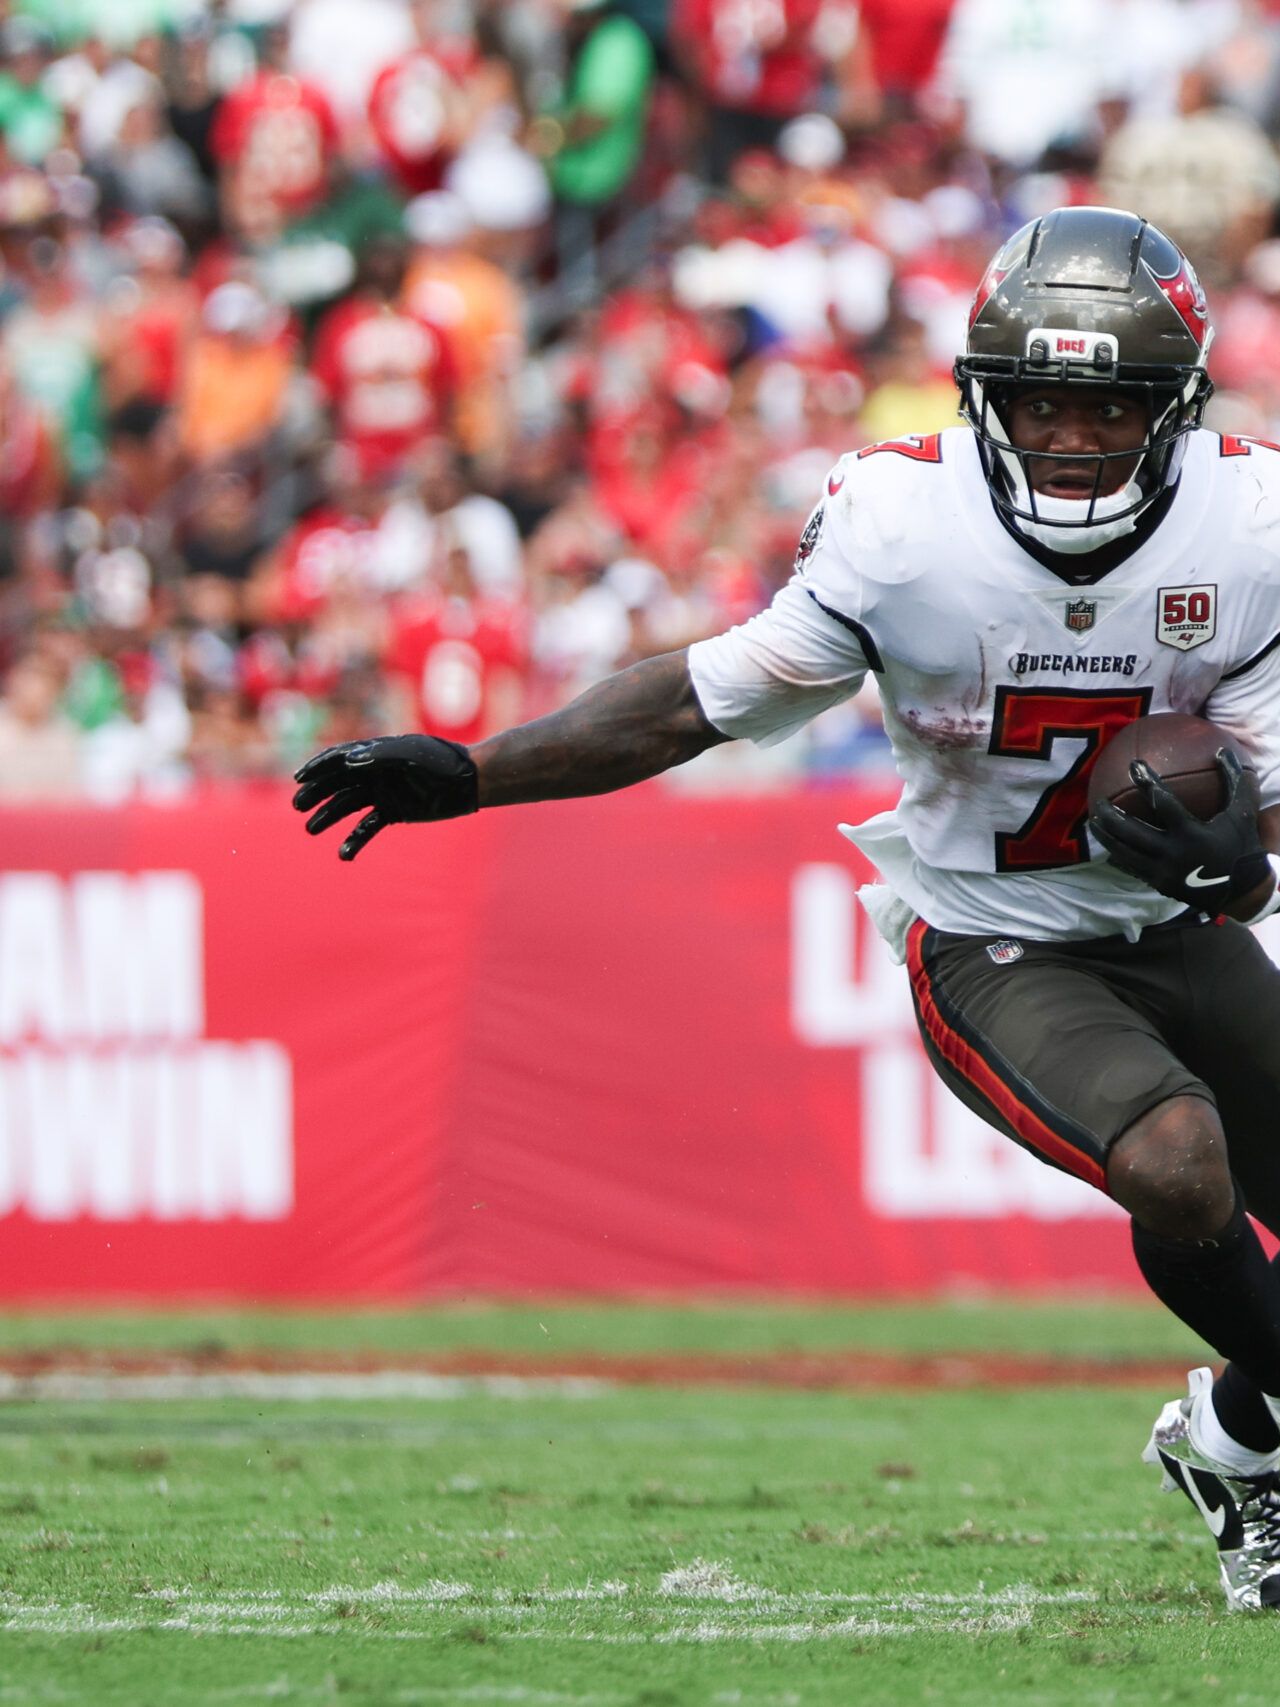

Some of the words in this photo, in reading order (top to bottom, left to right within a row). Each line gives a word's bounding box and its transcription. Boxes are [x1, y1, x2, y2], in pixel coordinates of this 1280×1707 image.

[1163, 591, 1210, 625] 50
[1016, 652, 1138, 677] BUCCANEERS
[988, 685, 1154, 872] 7
[0, 1038, 296, 1222] WIN
